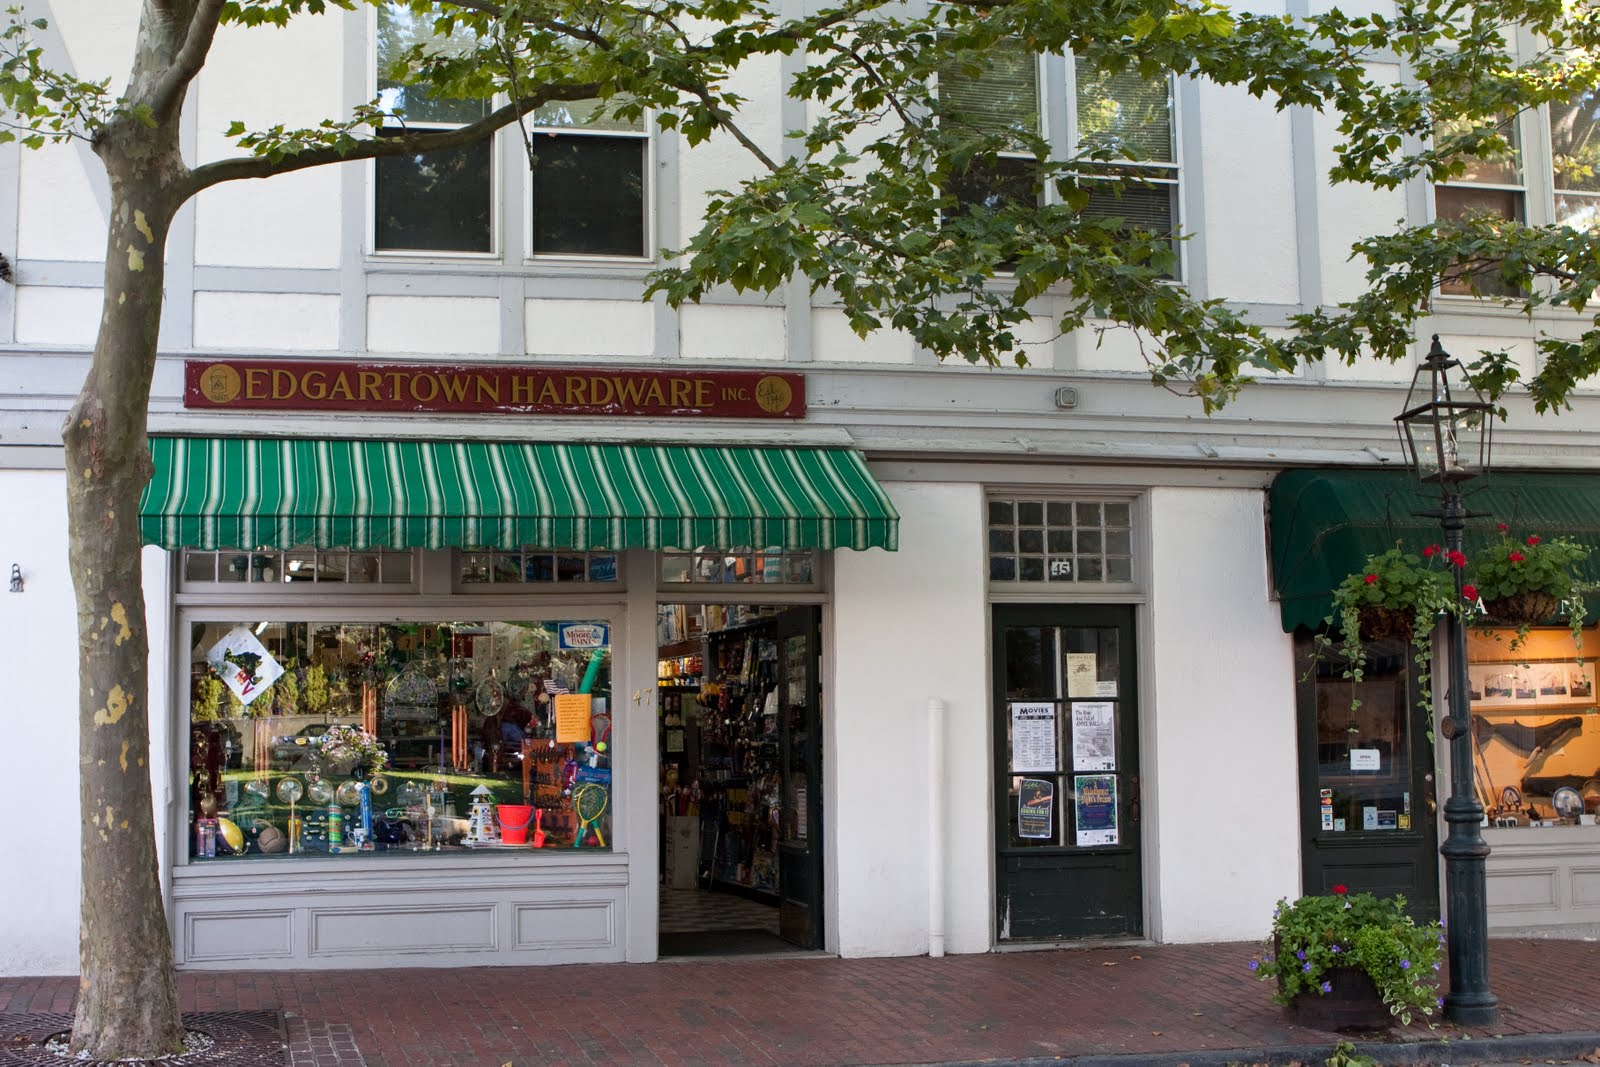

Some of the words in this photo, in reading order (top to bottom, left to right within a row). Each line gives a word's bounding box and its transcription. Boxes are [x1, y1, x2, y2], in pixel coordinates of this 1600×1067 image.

[245, 368, 500, 403] EDGARTOWN
[511, 374, 716, 408] HARDWARE
[720, 386, 751, 401] INC.
[1053, 563, 1069, 576] 45
[566, 631, 590, 639] Moore
[633, 688, 652, 706] 47
